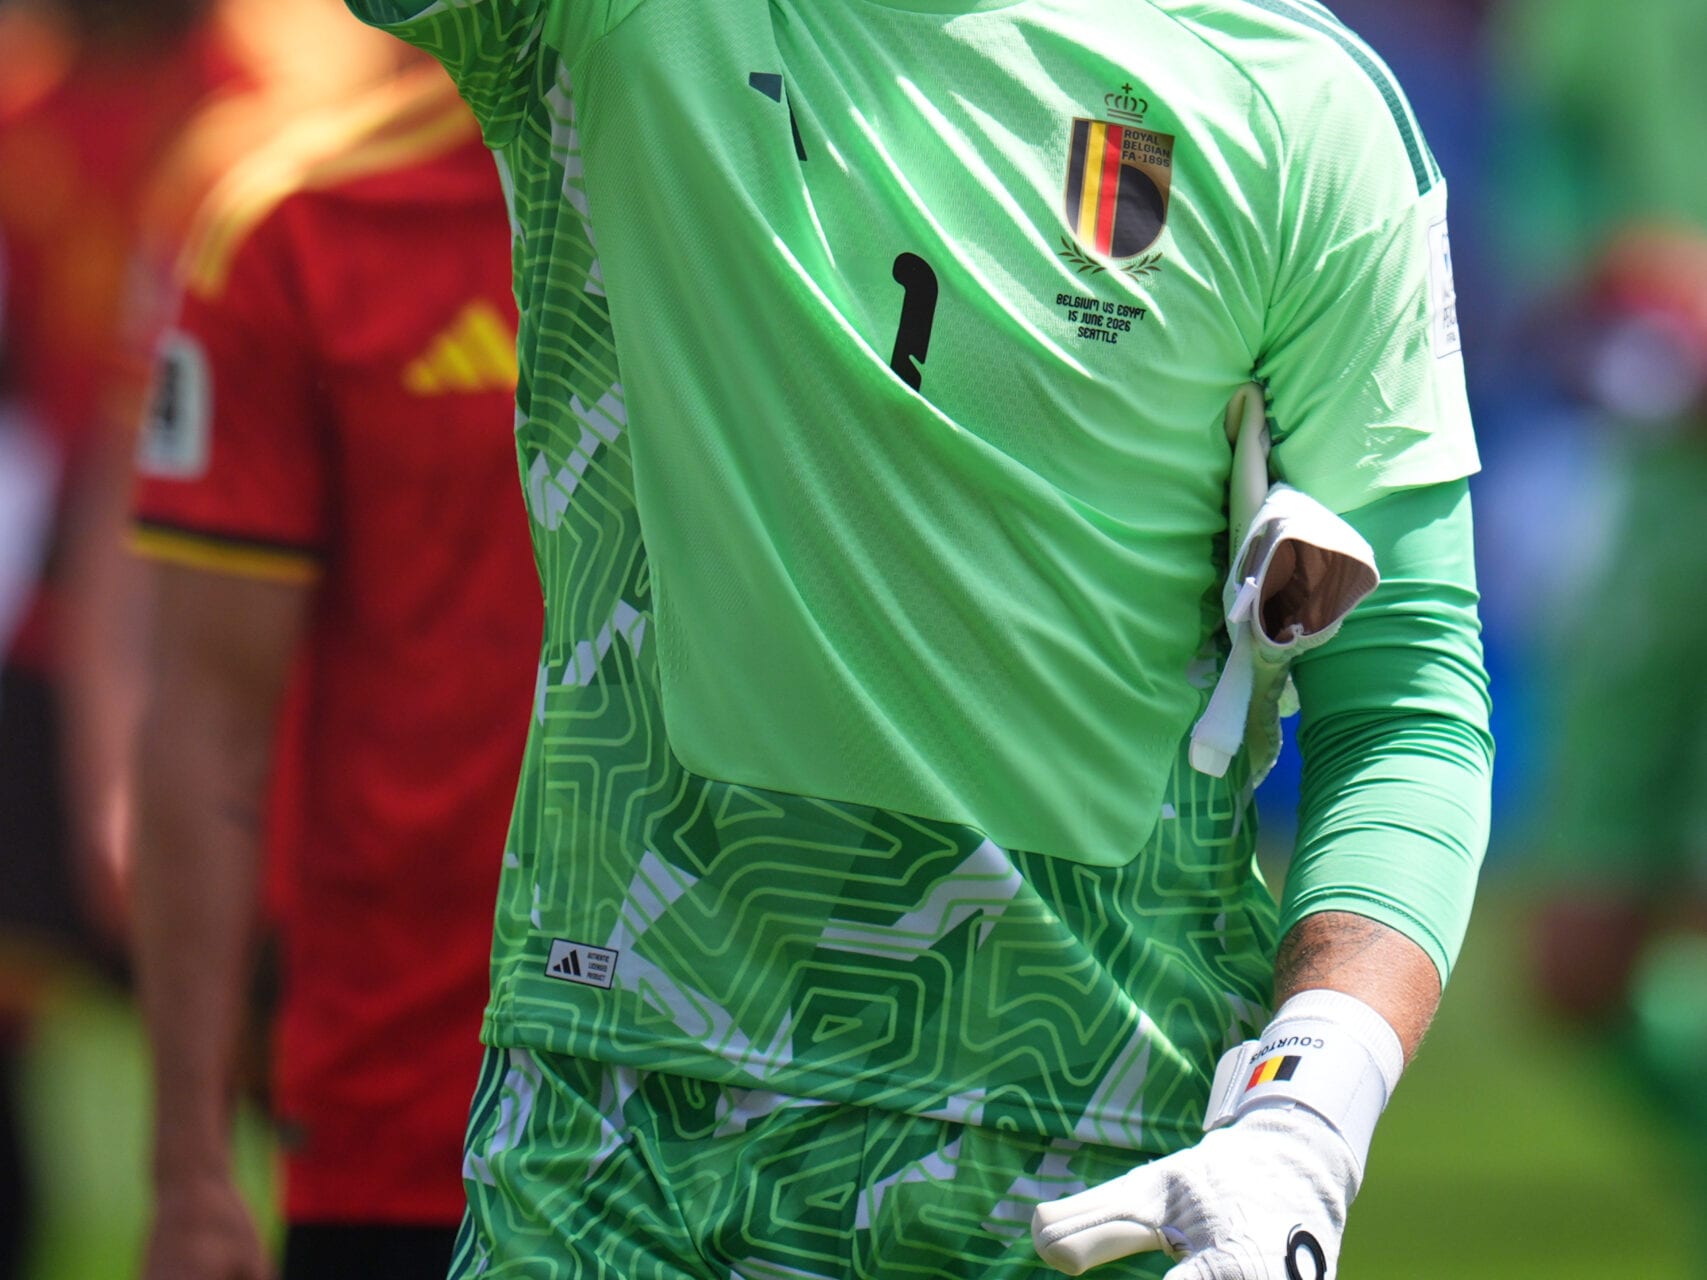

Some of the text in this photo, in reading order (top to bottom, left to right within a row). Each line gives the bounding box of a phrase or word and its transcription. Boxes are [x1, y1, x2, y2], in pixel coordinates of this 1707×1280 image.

[1124, 129, 1160, 146] ROYAL
[1123, 140, 1171, 158] BELGIAN
[1056, 293, 1100, 311] BELGIUM
[1117, 304, 1146, 320] EGYPT
[1067, 310, 1131, 332] 15 JUNE 2026
[1078, 326, 1118, 344] SEATTLE
[1249, 1036, 1325, 1065] COURTOIS
